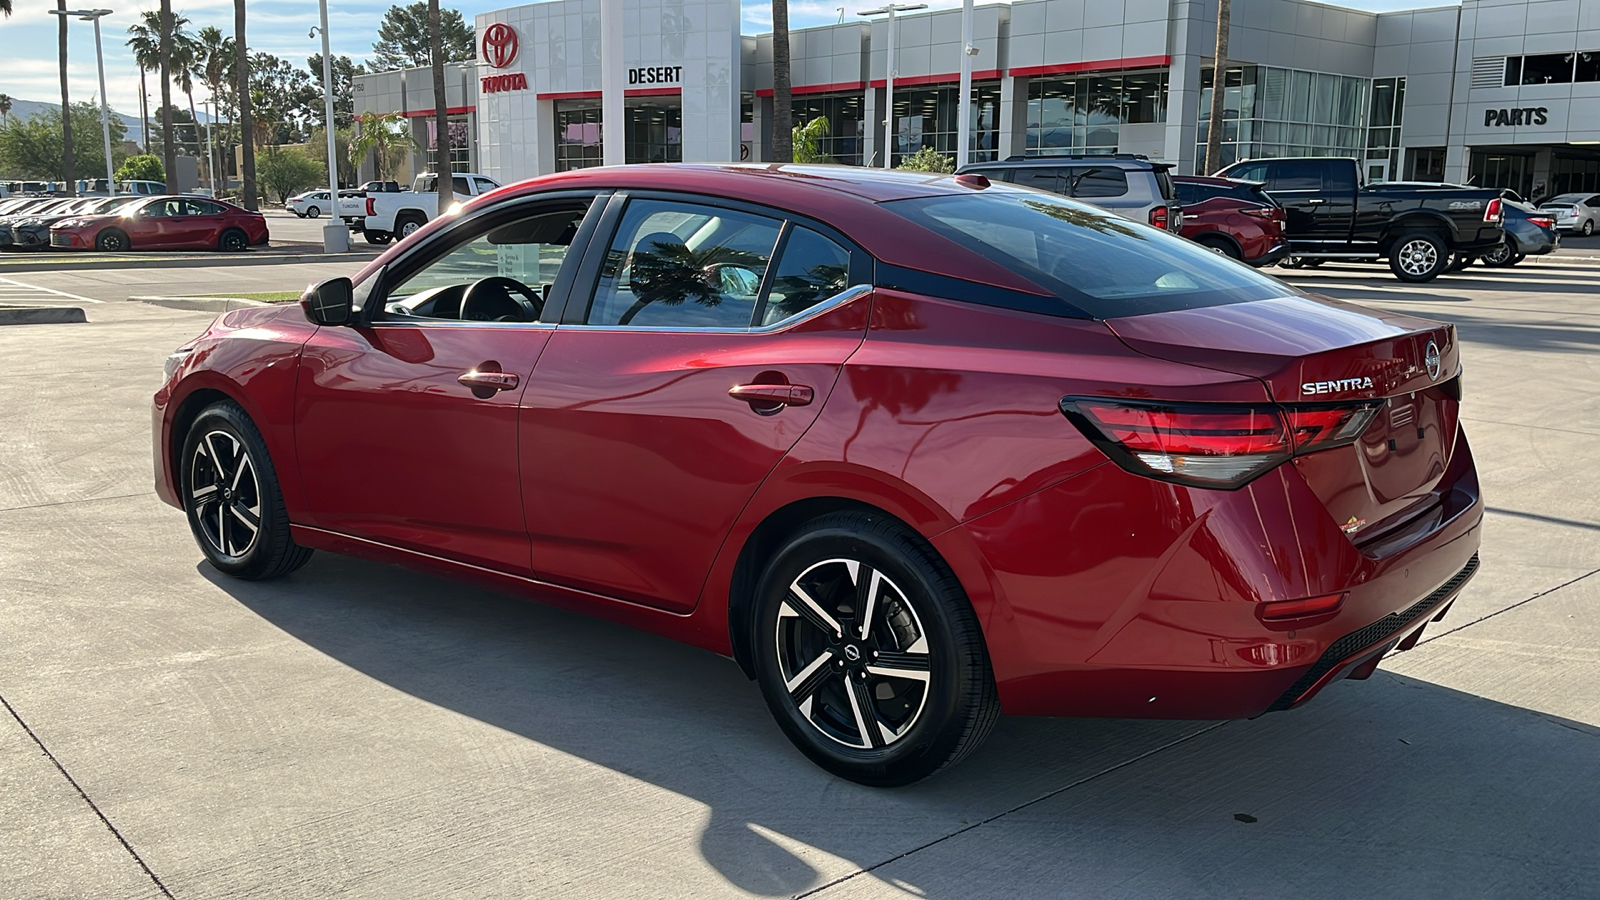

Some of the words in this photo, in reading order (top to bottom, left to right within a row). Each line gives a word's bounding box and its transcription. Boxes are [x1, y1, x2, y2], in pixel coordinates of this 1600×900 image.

[480, 73, 528, 93] TOYOTA
[629, 66, 682, 84] DESERT
[1484, 107, 1548, 127] PARTS
[1302, 376, 1373, 395] SENTRA
